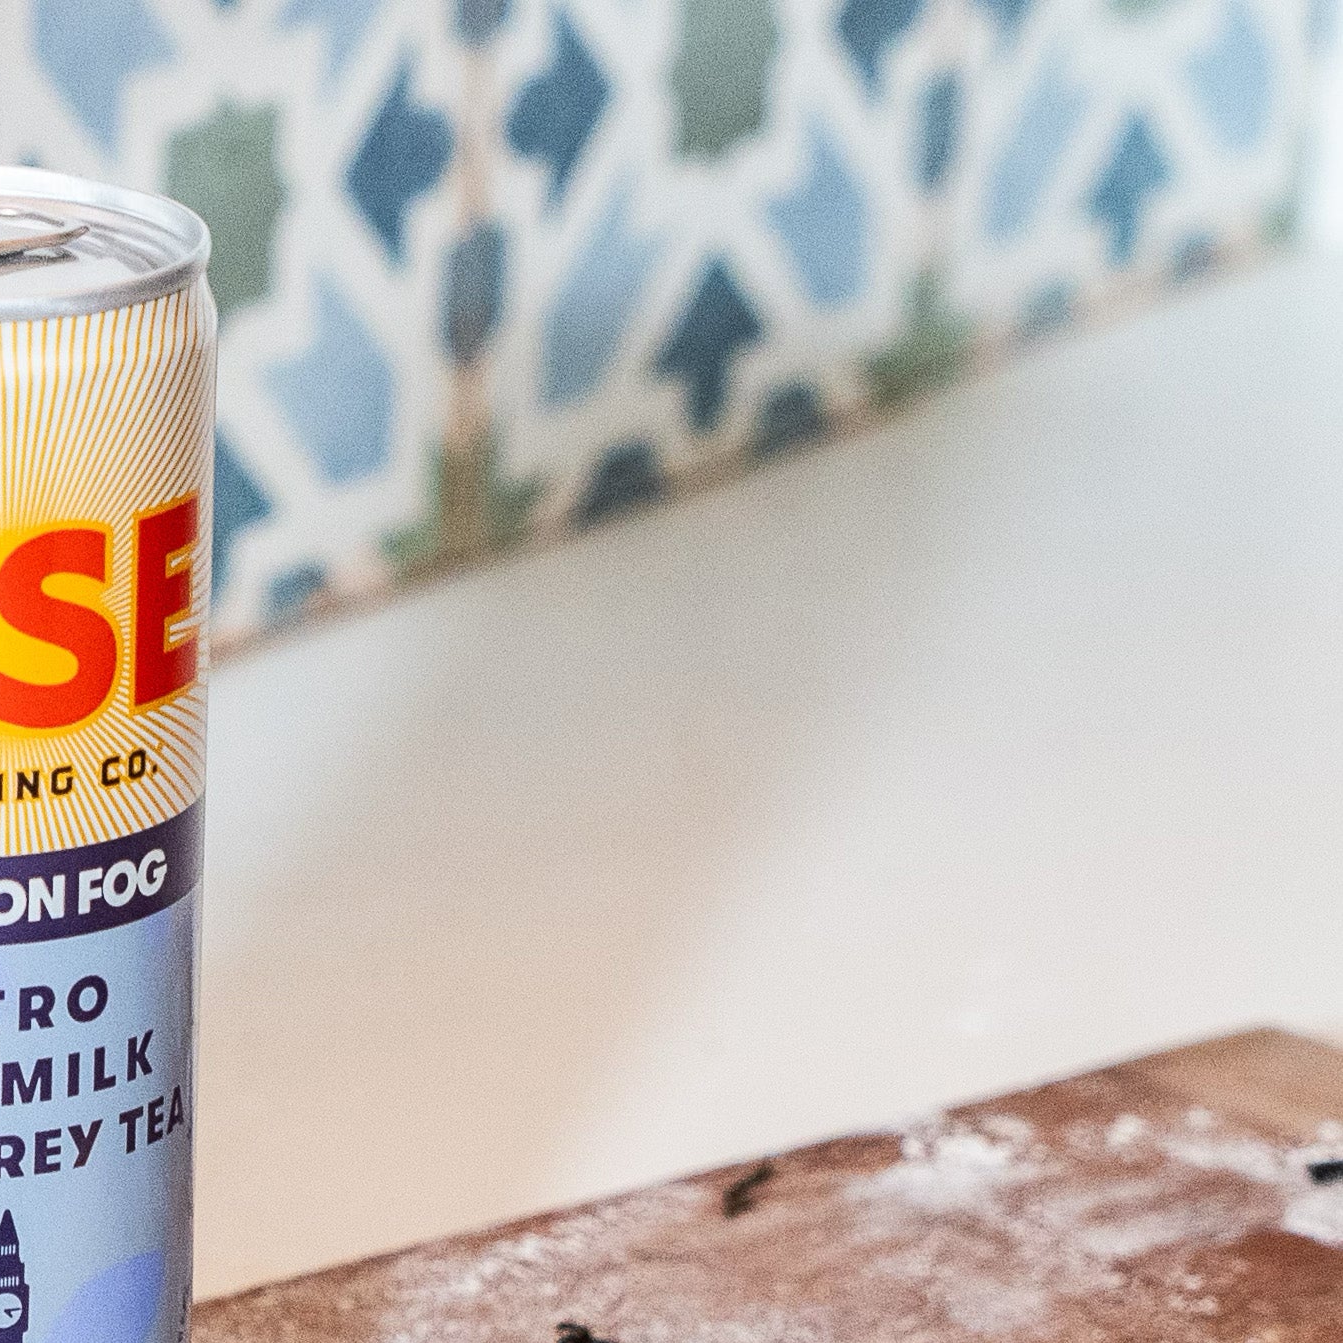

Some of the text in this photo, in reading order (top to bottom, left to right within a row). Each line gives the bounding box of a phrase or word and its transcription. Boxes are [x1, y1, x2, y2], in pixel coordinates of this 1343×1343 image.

[101, 749, 159, 787] CO.
[77, 848, 168, 914] FOG
[0, 1029, 155, 1106] MILK
[118, 1085, 185, 1154] TEA
